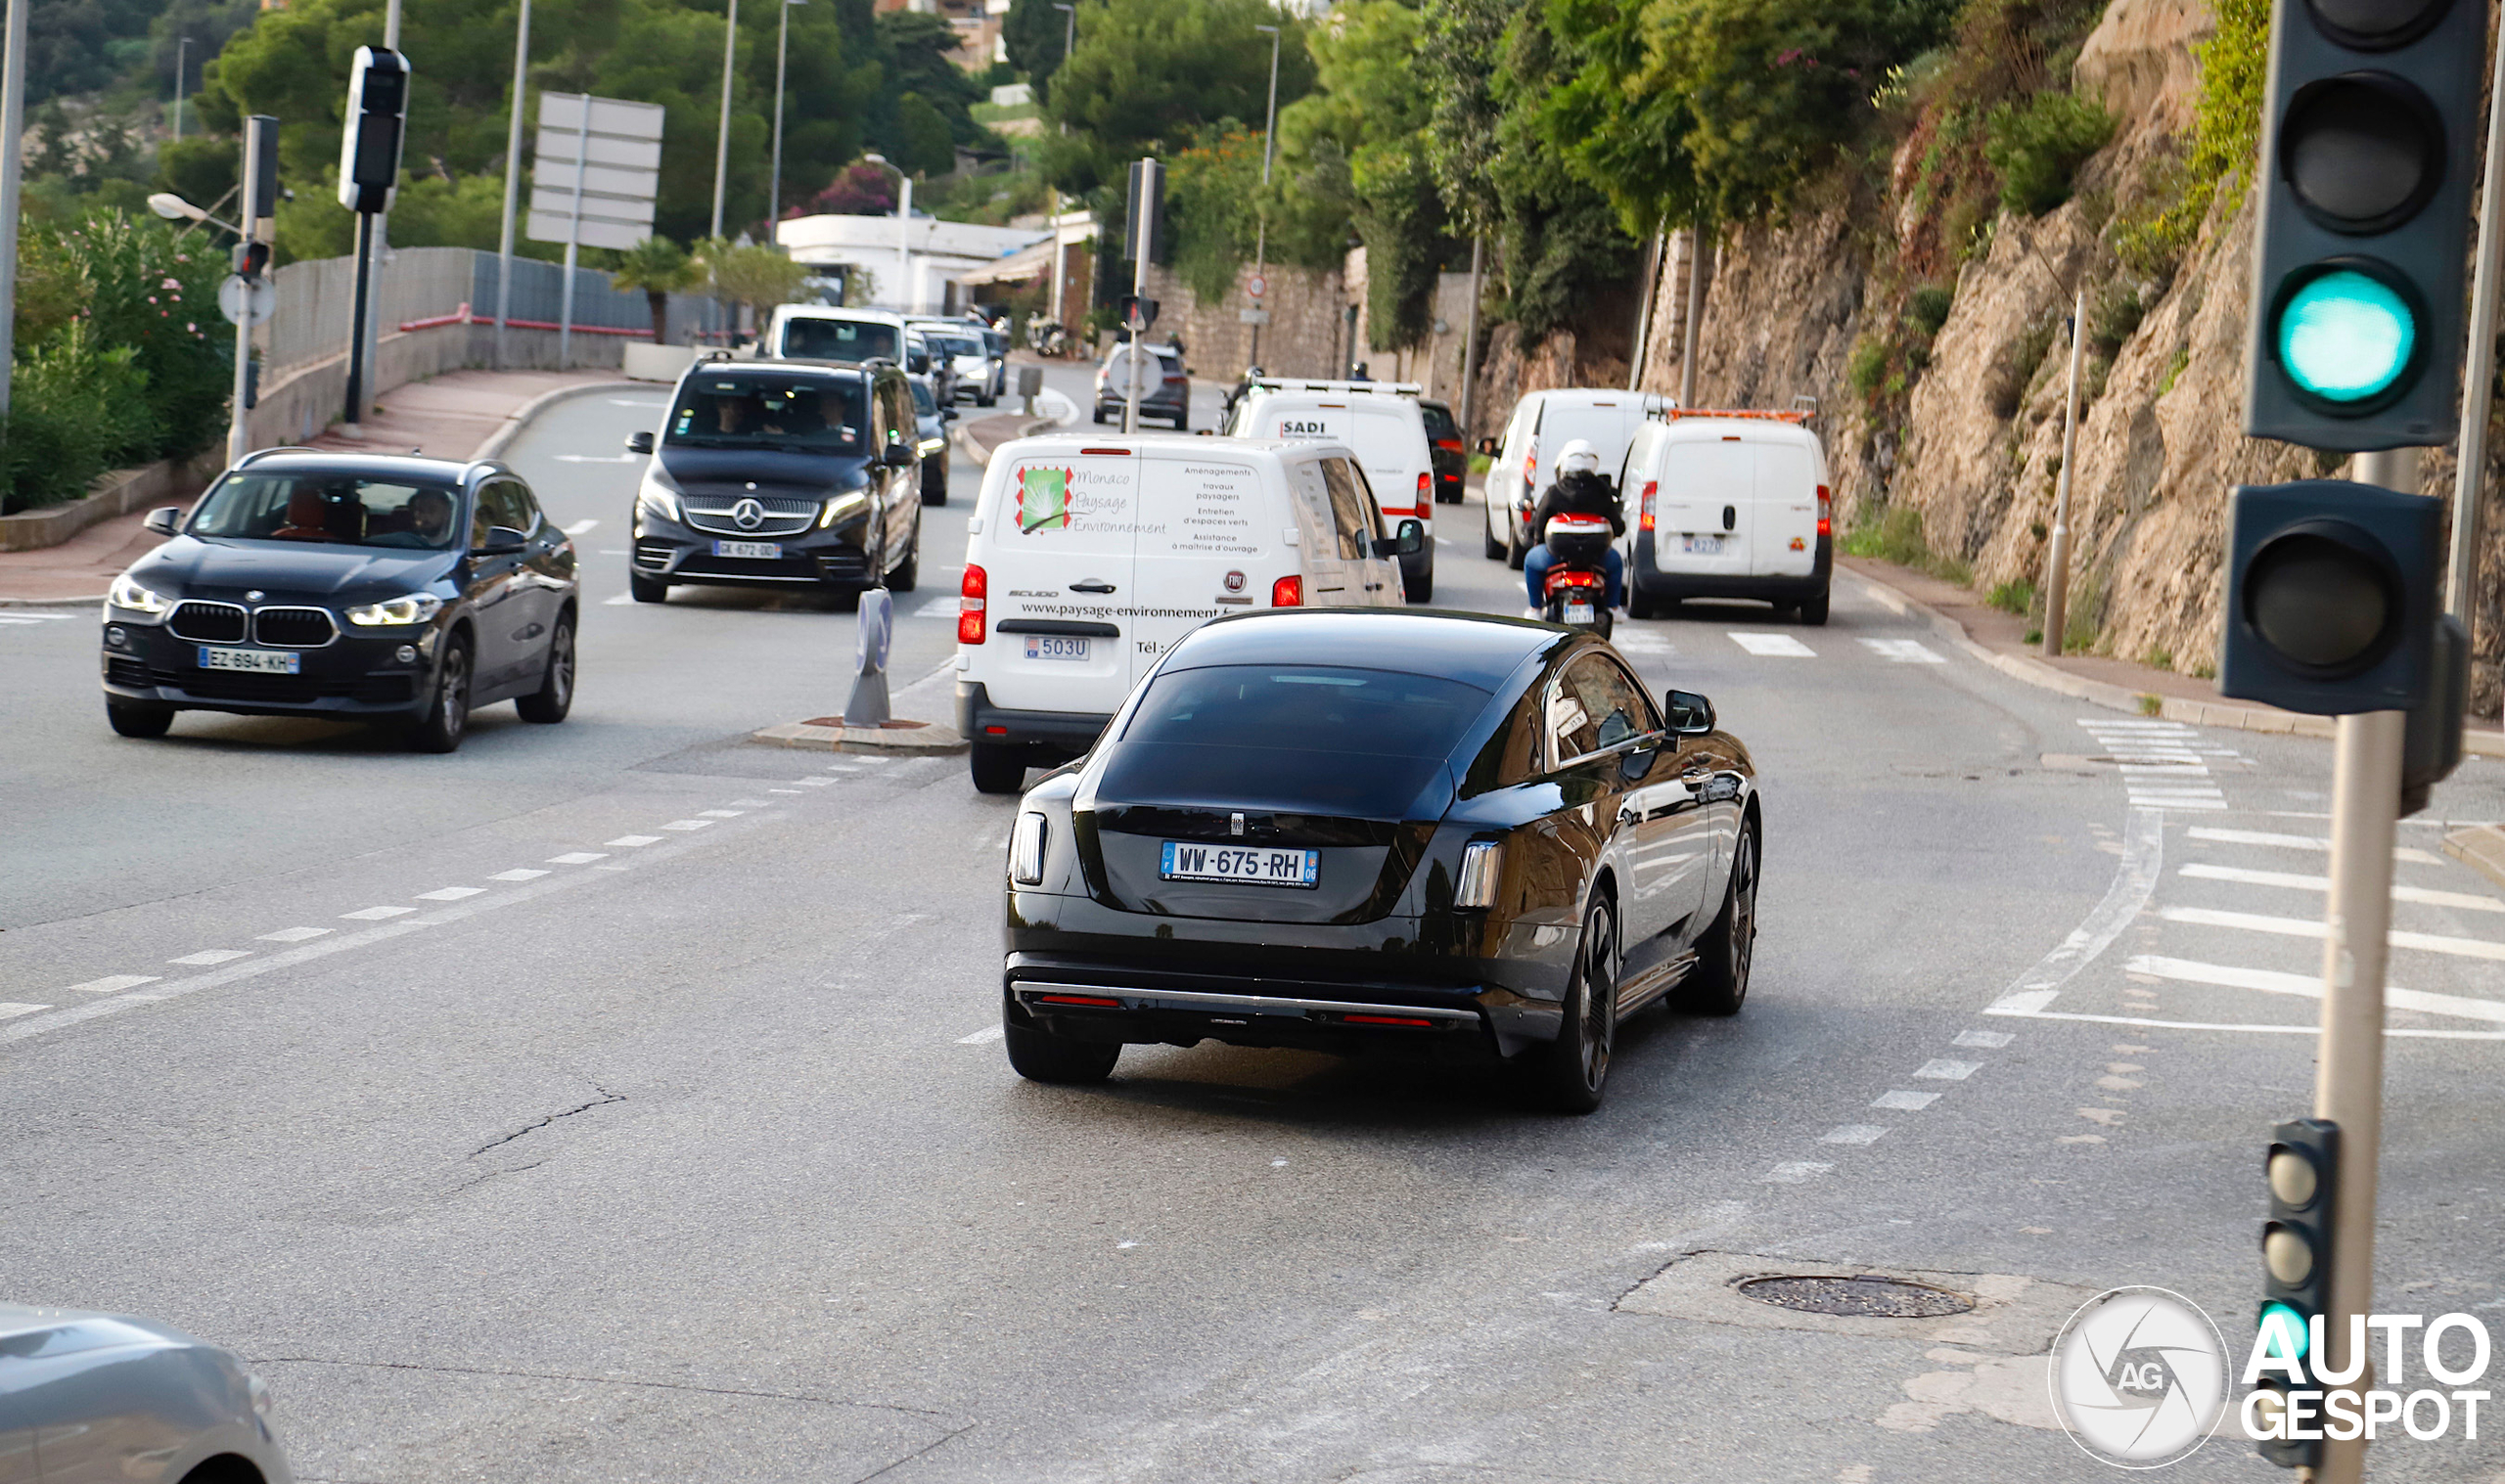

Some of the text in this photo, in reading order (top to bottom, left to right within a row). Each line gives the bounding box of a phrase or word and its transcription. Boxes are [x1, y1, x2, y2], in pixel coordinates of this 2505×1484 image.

[1283, 421, 1325, 433] SADI
[1076, 470, 1130, 485] Monaco
[1184, 467, 1252, 476] Aménagements
[1203, 482, 1234, 491] travaux
[1196, 492, 1240, 501] paysagers
[1075, 491, 1127, 515] Paysage
[1073, 517, 1167, 535] Environnement
[1183, 517, 1226, 525] d'espaces
[1193, 533, 1237, 542] Assistance
[1171, 541, 1177, 550] à
[1214, 544, 1258, 555] d'ouvrage
[1228, 575, 1243, 587] FIAT
[1022, 603, 1235, 618] www.paysage-environnementf
[1043, 639, 1085, 655] 503U
[1136, 641, 1157, 653] Tél
[1179, 848, 1298, 878] WW-675-RH
[1304, 869, 1317, 880] 06
